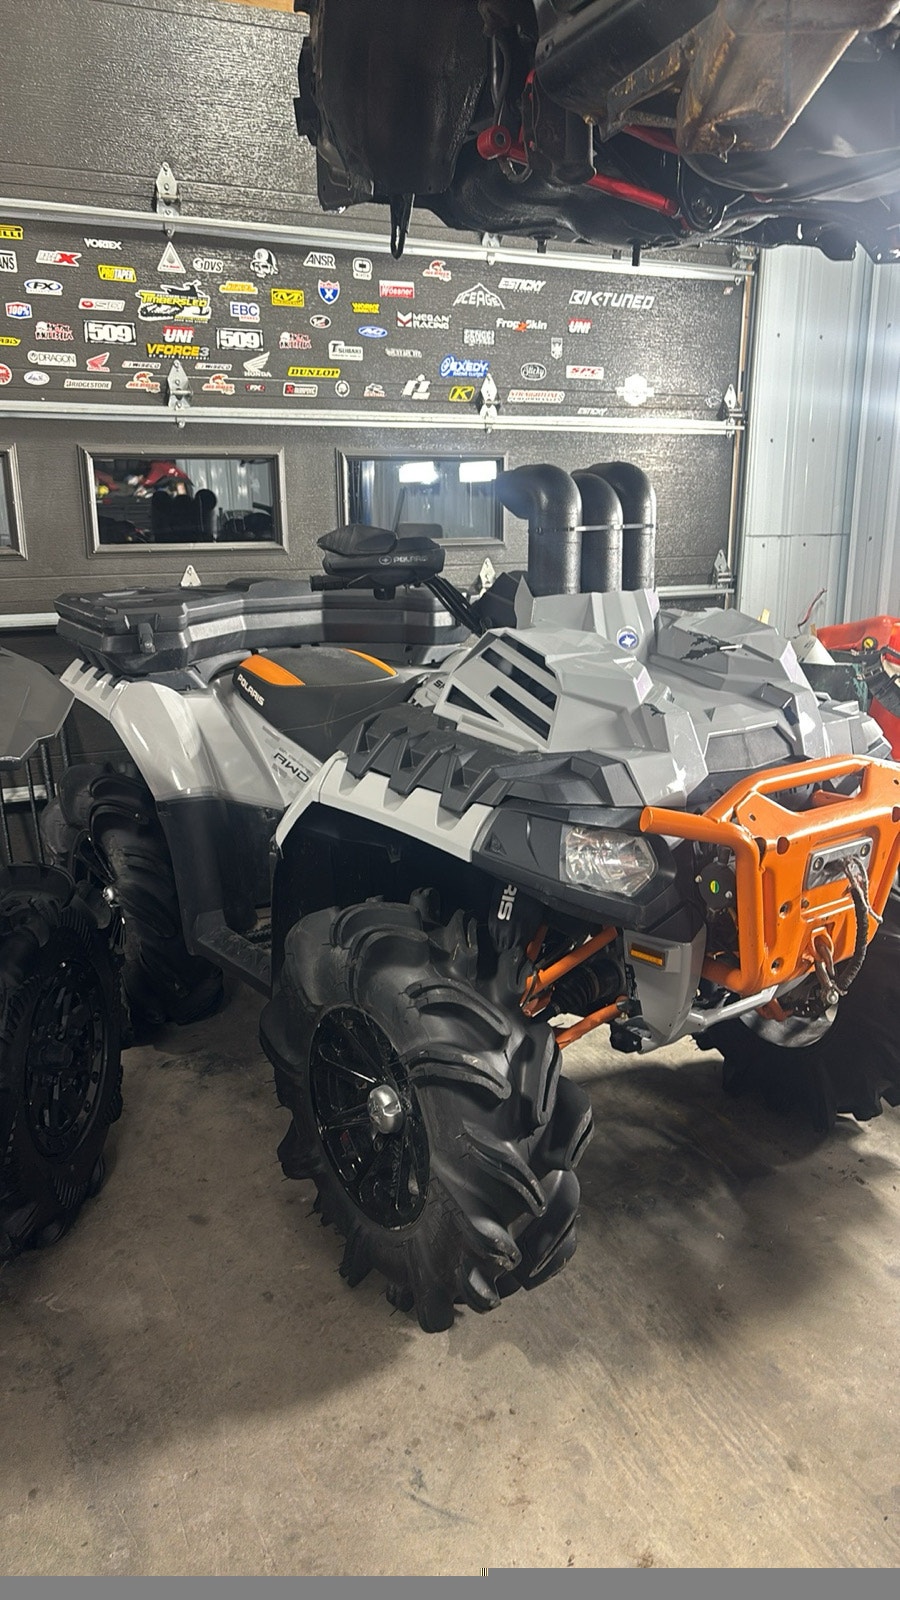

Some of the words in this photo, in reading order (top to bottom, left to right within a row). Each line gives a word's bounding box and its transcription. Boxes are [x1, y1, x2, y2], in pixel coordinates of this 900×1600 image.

[84, 238, 122, 250] VORTEX
[203, 261, 223, 271] DVS
[306, 254, 334, 267] ANSR
[231, 304, 258, 316] EBC
[88, 322, 132, 342] 509
[568, 320, 591, 334] UNI
[164, 328, 193, 343] UNI
[220, 330, 260, 348] 509
[38, 353, 75, 363] DRAGON
[291, 368, 339, 377] DUNLOP
[237, 673, 265, 706] POLARIS
[274, 752, 310, 783] AWD
